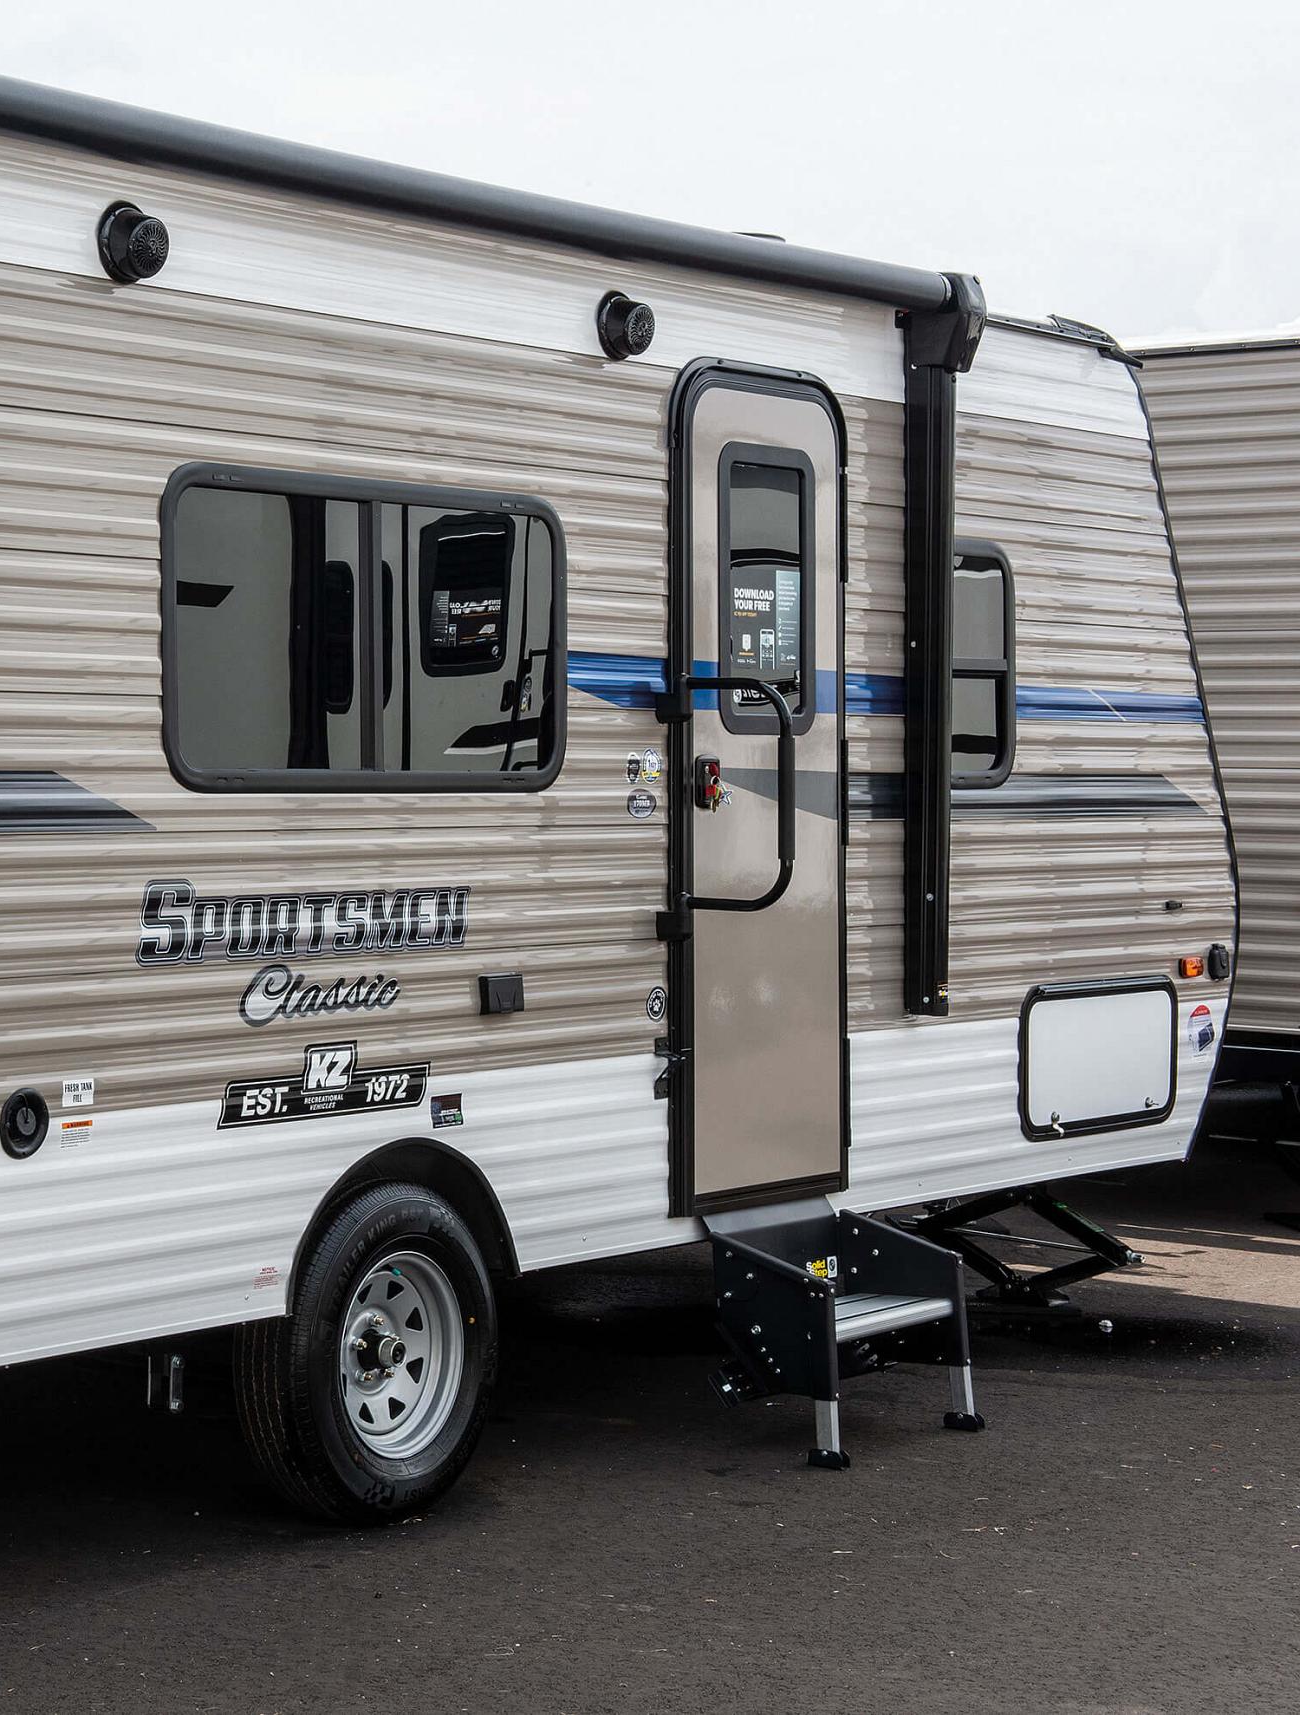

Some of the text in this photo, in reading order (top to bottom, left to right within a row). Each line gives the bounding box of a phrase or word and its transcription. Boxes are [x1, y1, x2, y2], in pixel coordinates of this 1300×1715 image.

[733, 587, 775, 601] DOWNLOAD
[733, 599, 771, 612] YOUR FREE
[238, 963, 401, 1028] Classic
[307, 1050, 352, 1090] KZ
[64, 1081, 93, 1093] FRESH TANK
[73, 1094, 83, 1103] FILL
[240, 1073, 411, 1118] EST. 1972
[304, 1093, 344, 1106] RECREATIONAL
[309, 1101, 337, 1111] VEHICLES
[805, 1259, 826, 1271] Solid
